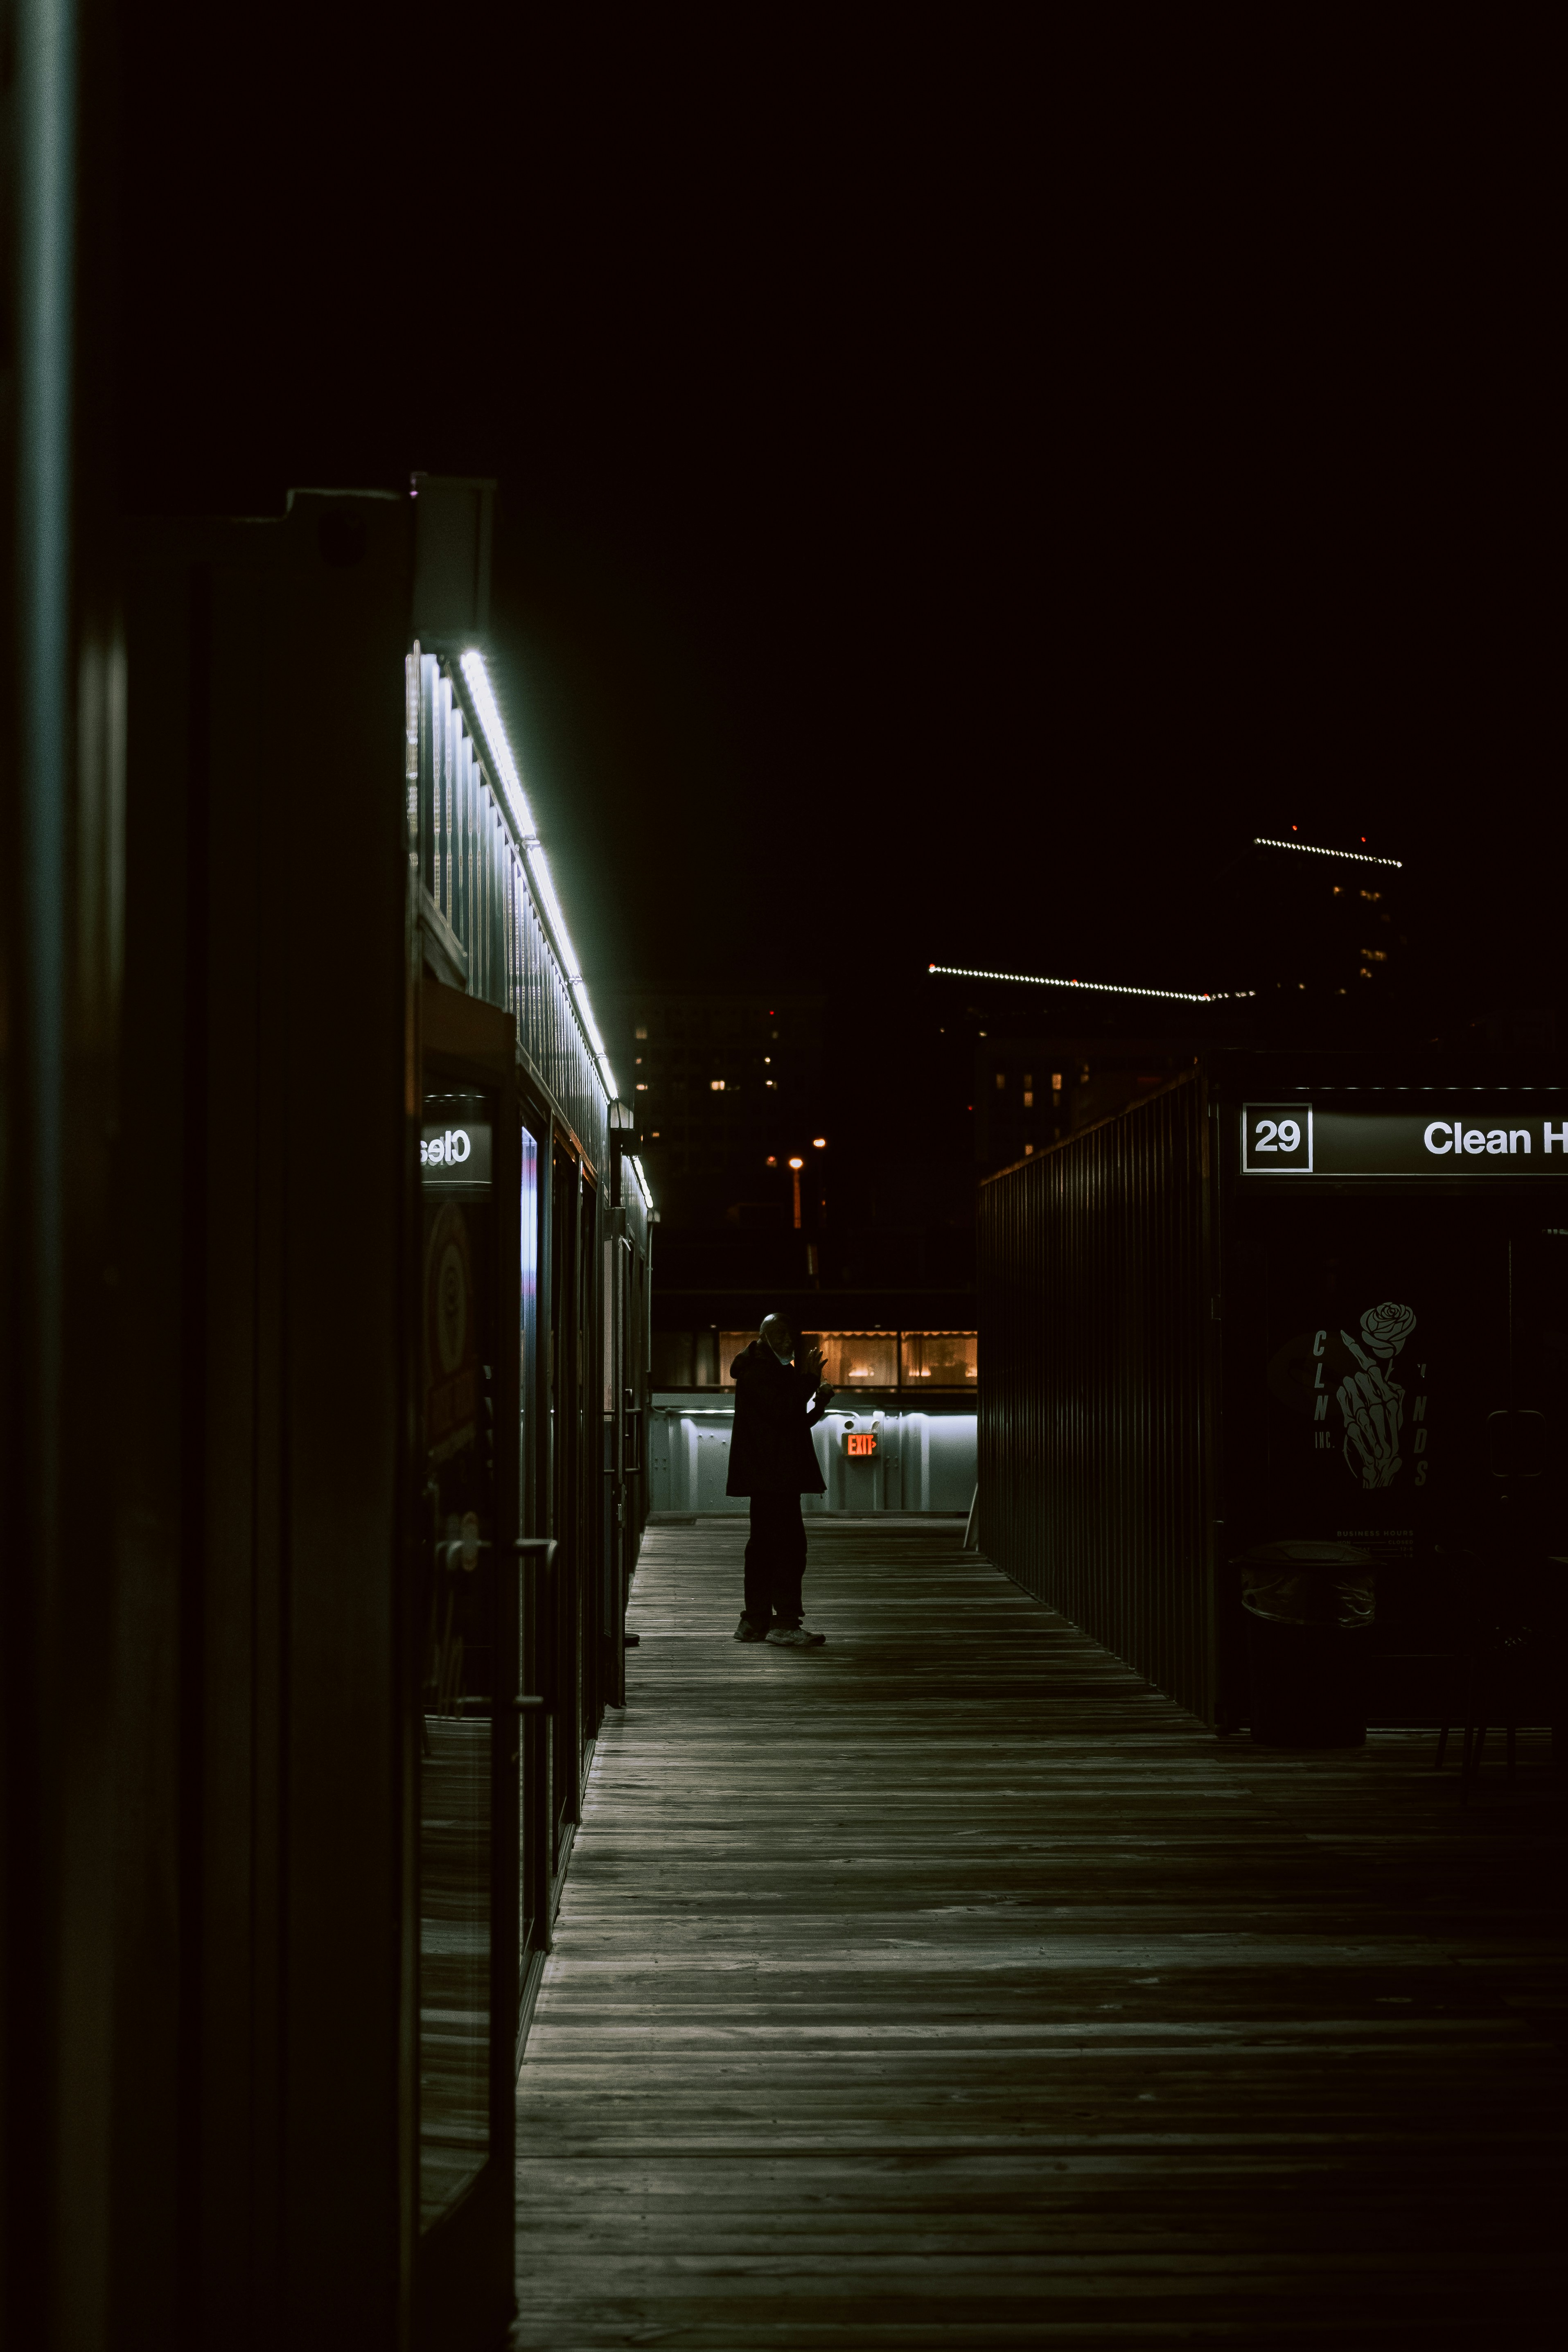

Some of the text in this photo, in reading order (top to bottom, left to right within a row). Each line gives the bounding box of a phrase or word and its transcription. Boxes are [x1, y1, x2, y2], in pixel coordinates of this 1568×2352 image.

[1255, 1120, 1300, 1152] 29
[1424, 1122, 1531, 1154] Clean
[848, 1435, 873, 1455] EXIT
[1315, 1431, 1335, 1449] INC.
